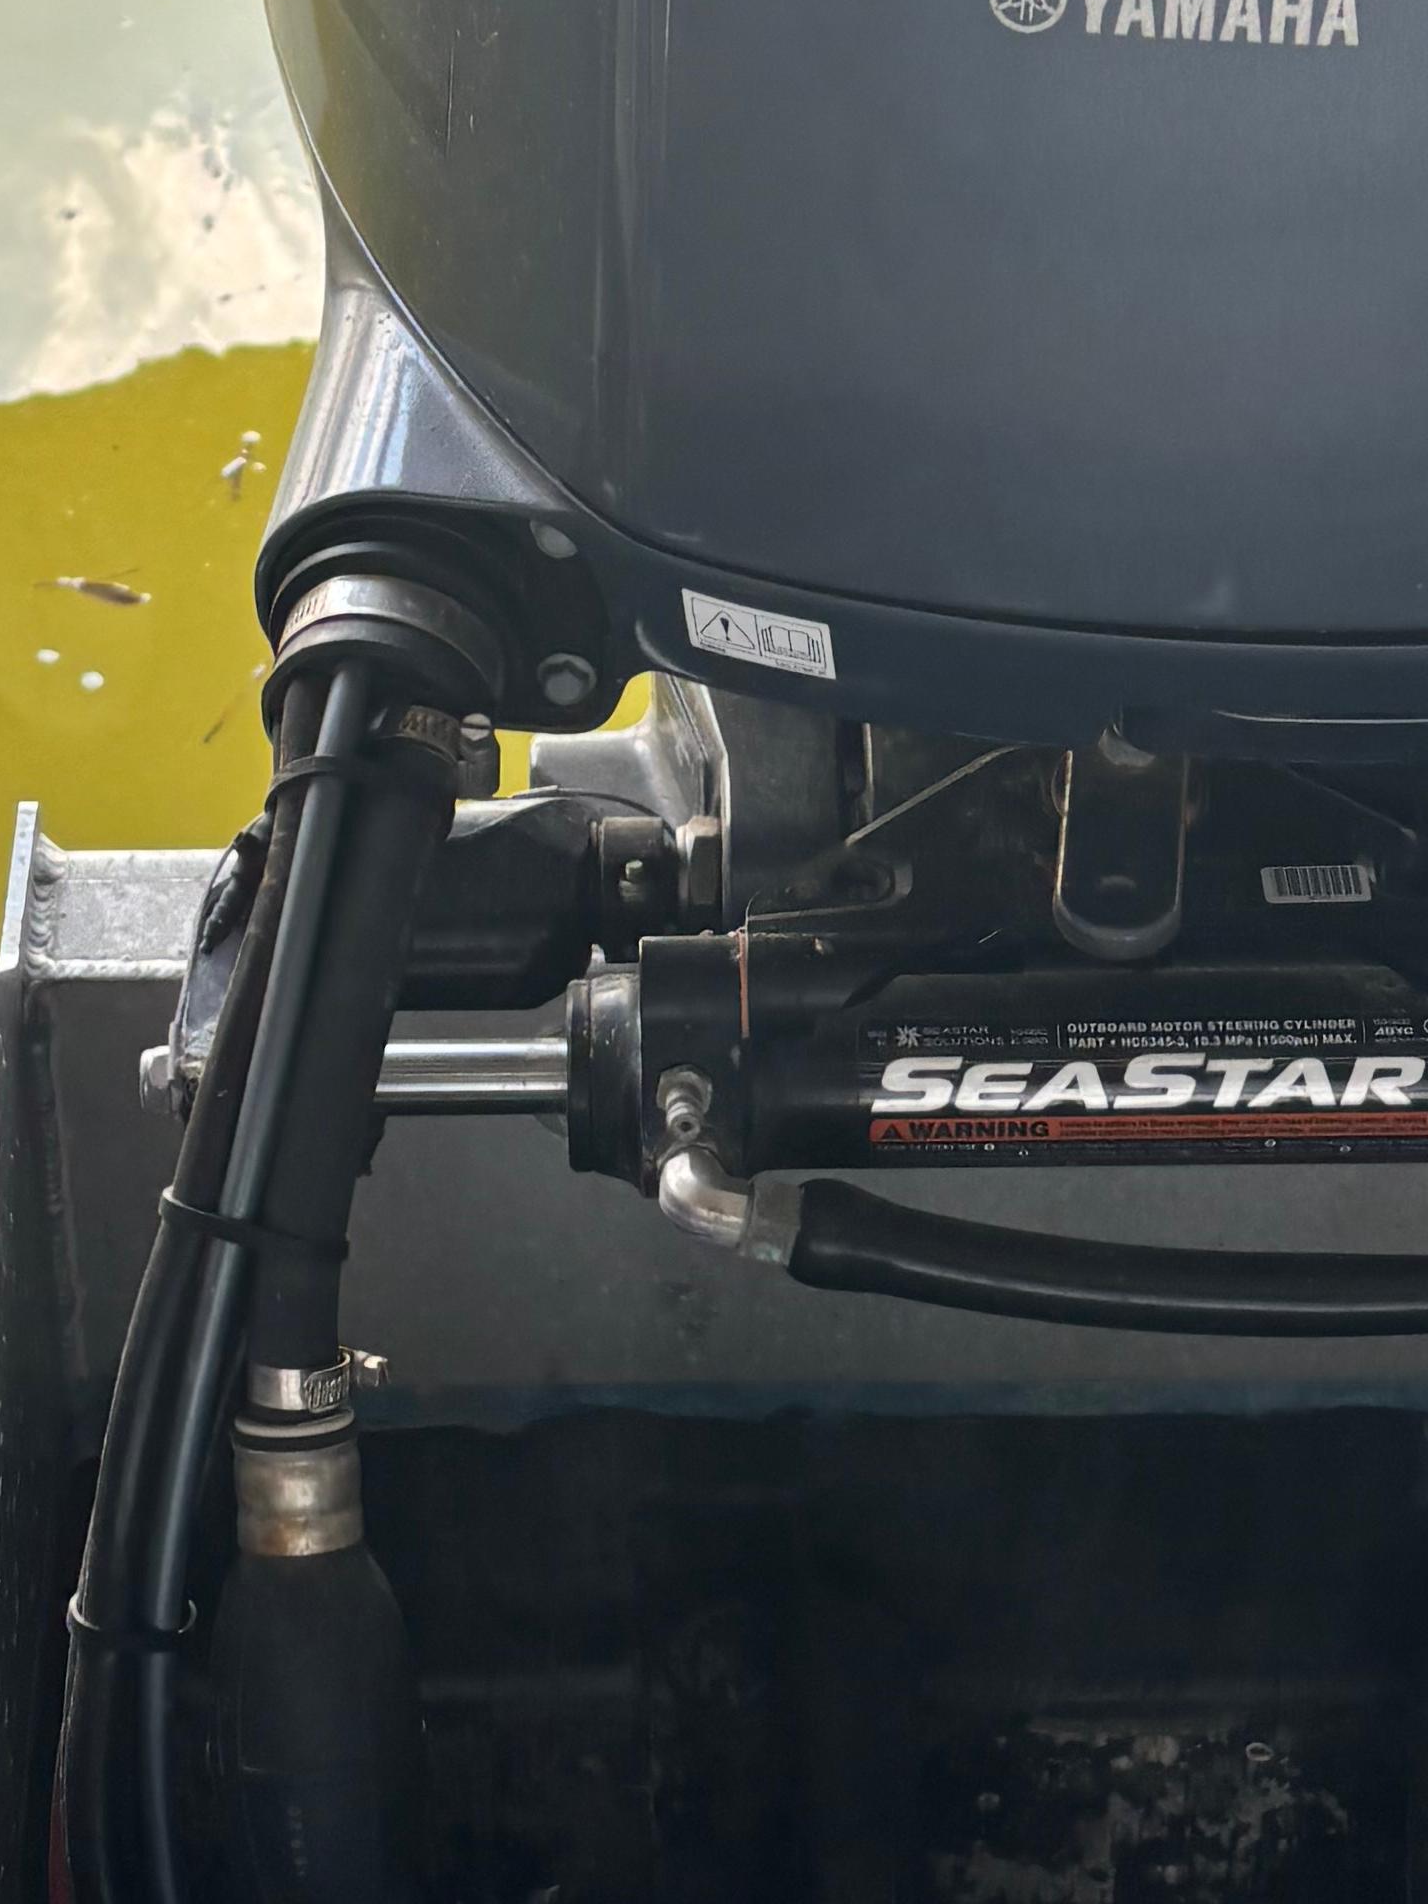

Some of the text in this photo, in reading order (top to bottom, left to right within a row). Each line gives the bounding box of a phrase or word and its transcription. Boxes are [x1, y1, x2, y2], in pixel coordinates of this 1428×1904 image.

[1067, 1019, 1356, 1034] OUTBOARD MOTOR STEERING CYLINDER
[1068, 1037, 1105, 1048] PART
[871, 1052, 1426, 1112] SEASTAR
[908, 1120, 1049, 1139] WARNING
